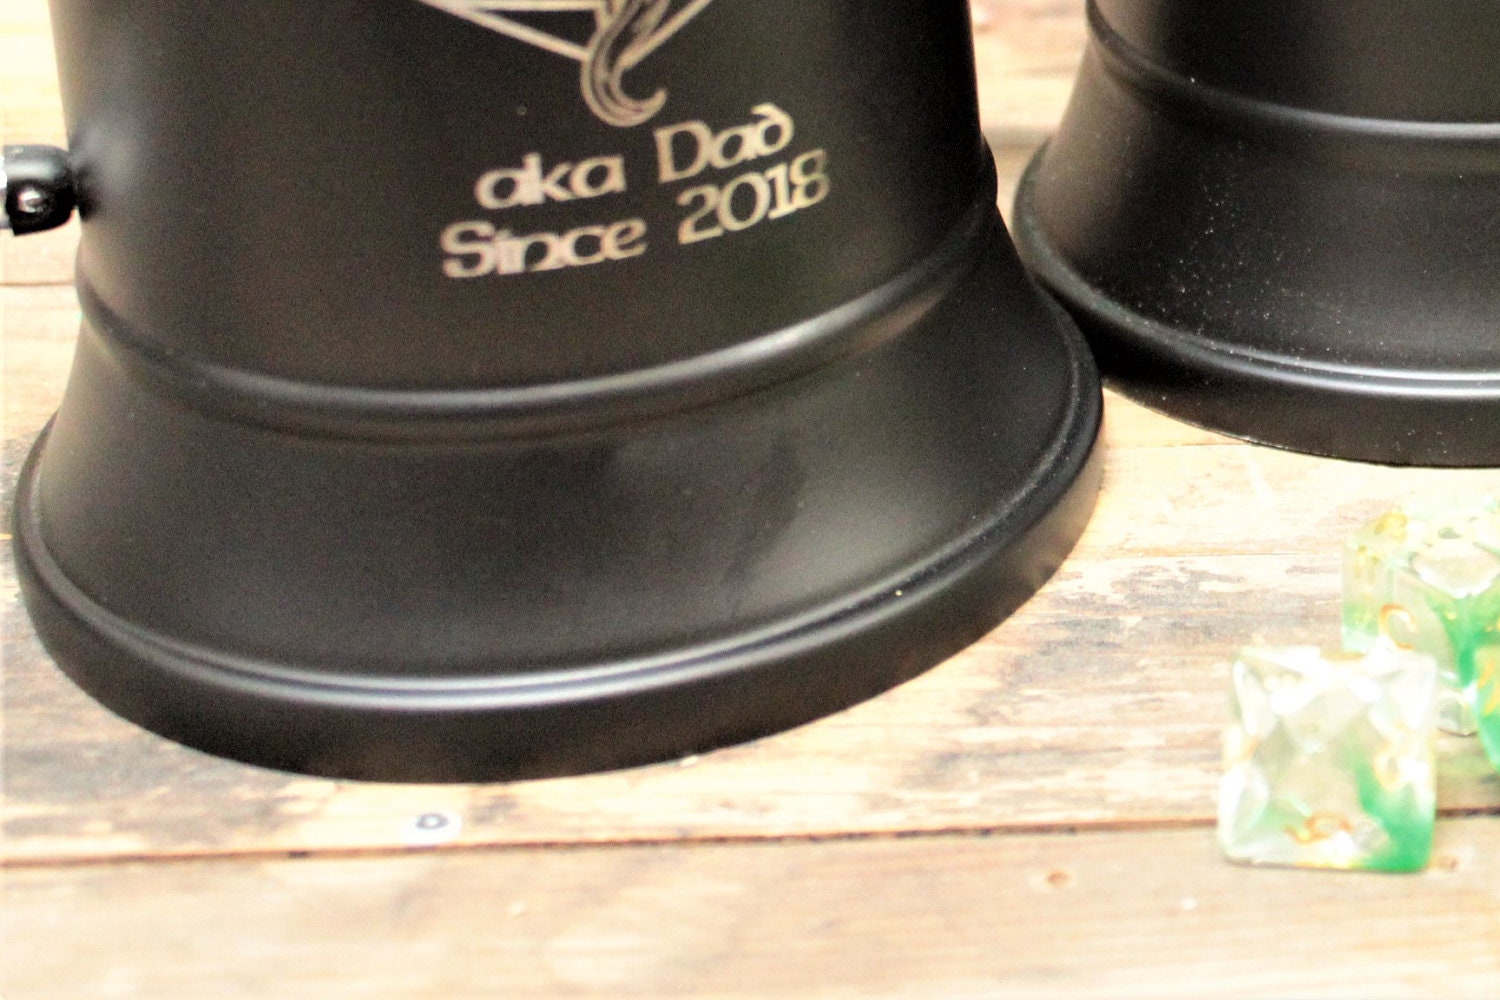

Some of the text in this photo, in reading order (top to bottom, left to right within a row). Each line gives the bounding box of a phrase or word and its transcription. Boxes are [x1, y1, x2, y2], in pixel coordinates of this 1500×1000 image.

[439, 148, 831, 279] Since 2018
[474, 102, 795, 210] aka Dad
